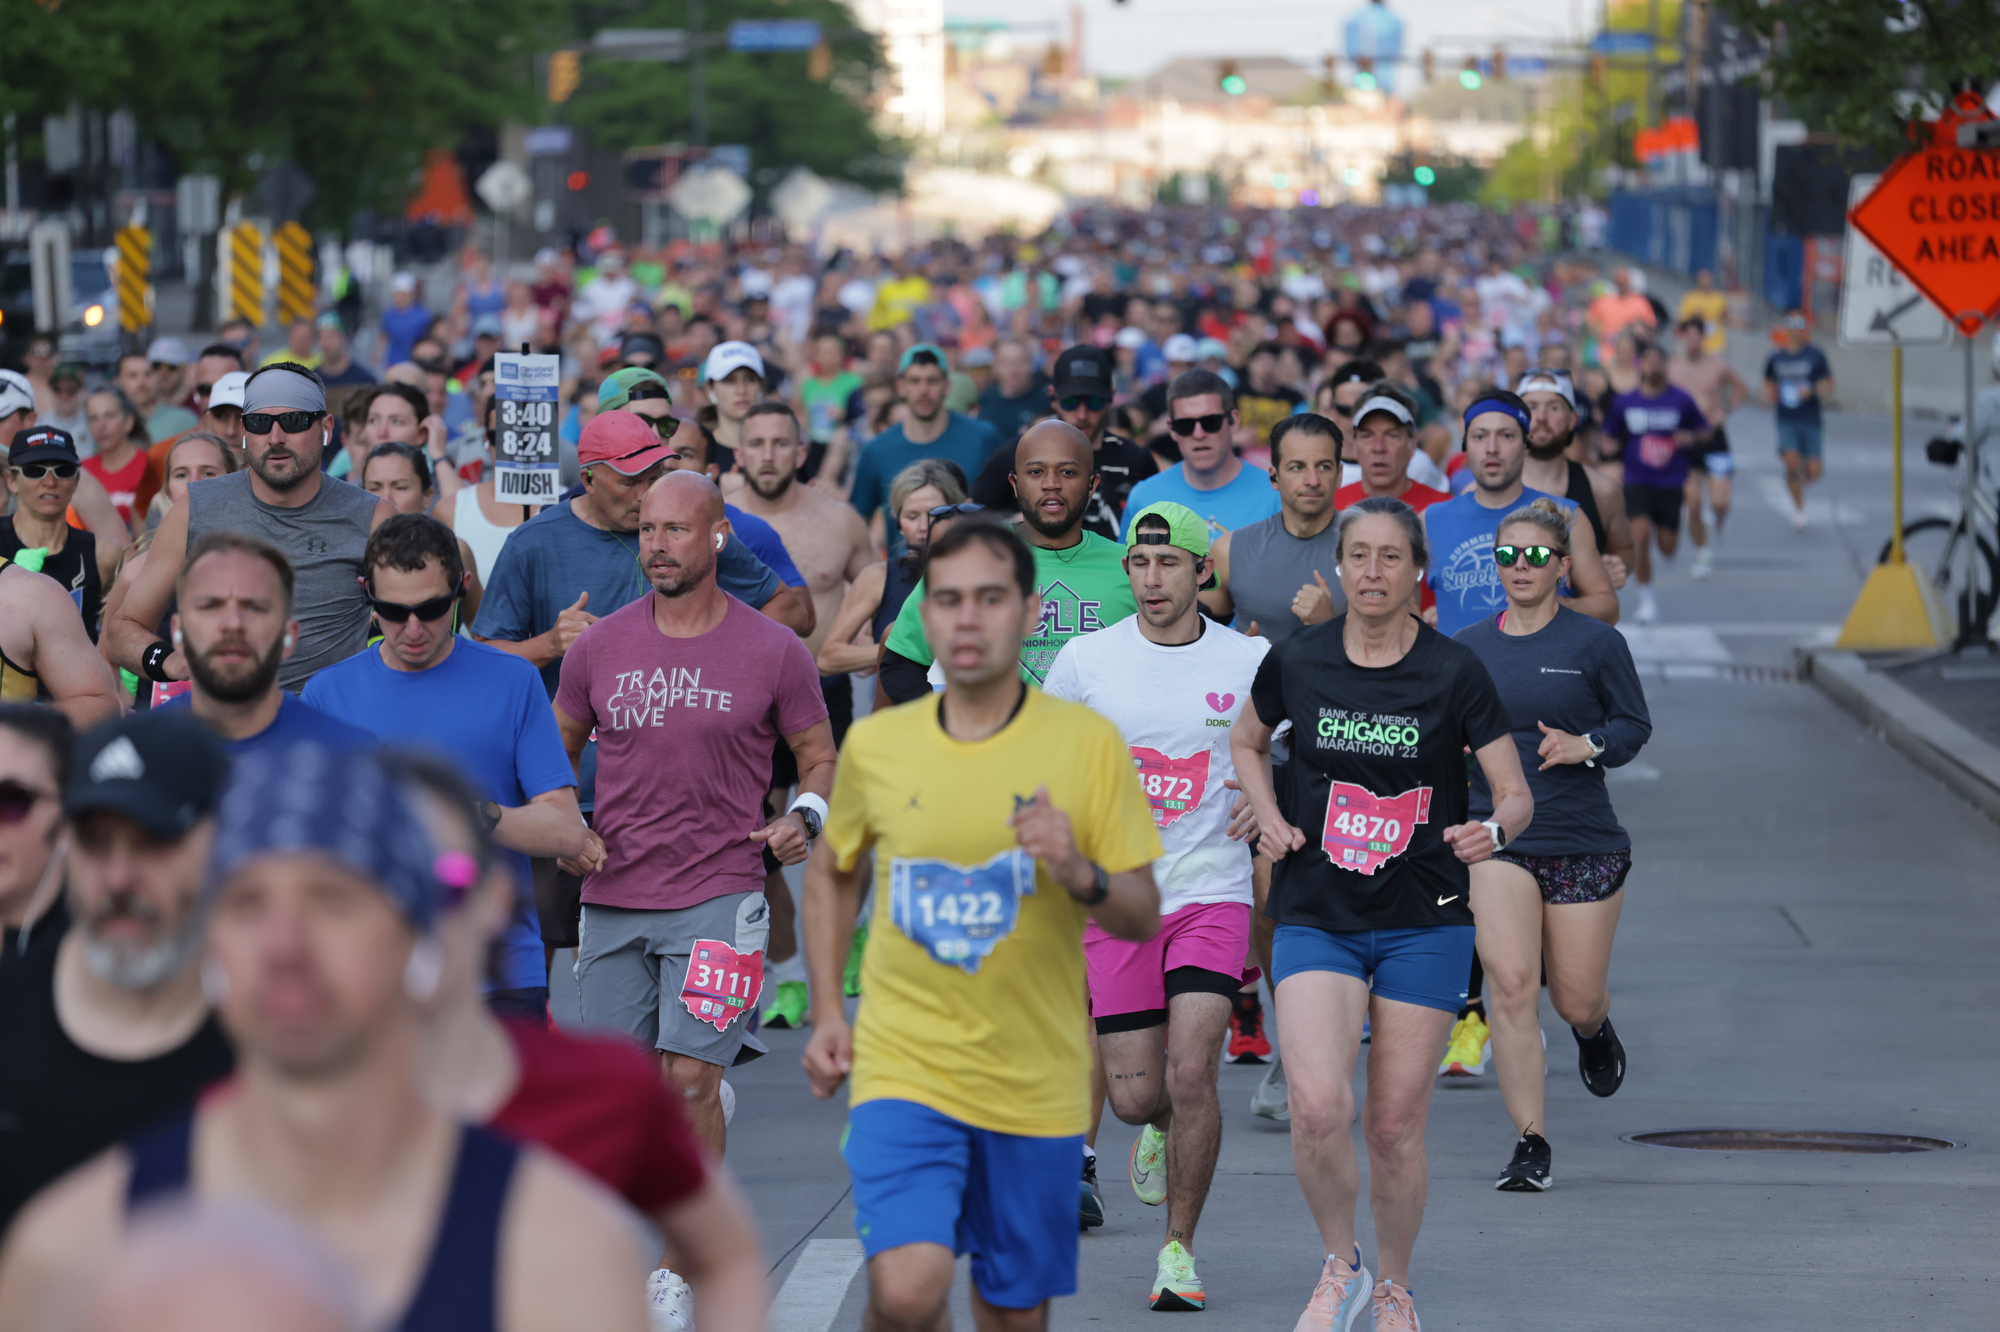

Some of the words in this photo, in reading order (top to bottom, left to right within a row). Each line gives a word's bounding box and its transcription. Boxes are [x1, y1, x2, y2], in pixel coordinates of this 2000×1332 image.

[1908, 193, 2000, 224] CLOSE
[1914, 235, 2000, 264] AHEA
[502, 400, 552, 426] 3:40
[503, 430, 552, 456] 8:24
[501, 471, 553, 496] MUSH
[1449, 533, 1493, 561] SUMMER
[1022, 639, 1069, 648] NIONHOM
[1024, 650, 1060, 662] CLEV
[615, 667, 701, 693] TRAIN
[607, 687, 732, 713] COMPETE
[613, 706, 665, 731] LIVE
[1205, 718, 1232, 728] DDRC
[1319, 707, 1348, 720] BANK
[1352, 711, 1367, 722] OF
[1370, 714, 1419, 728] AMERICA
[1318, 717, 1419, 746] CHICAGO
[1316, 736, 1395, 757] MARATHON
[1398, 745, 1418, 758] '22
[1165, 800, 1181, 810] 13.1
[1333, 811, 1401, 843] 4870
[1370, 842, 1387, 852] 13.1
[917, 891, 1003, 928] 1422
[694, 964, 751, 998] 3111
[727, 996, 741, 1008] 13.1
[1171, 1229, 1184, 1239] XIX
